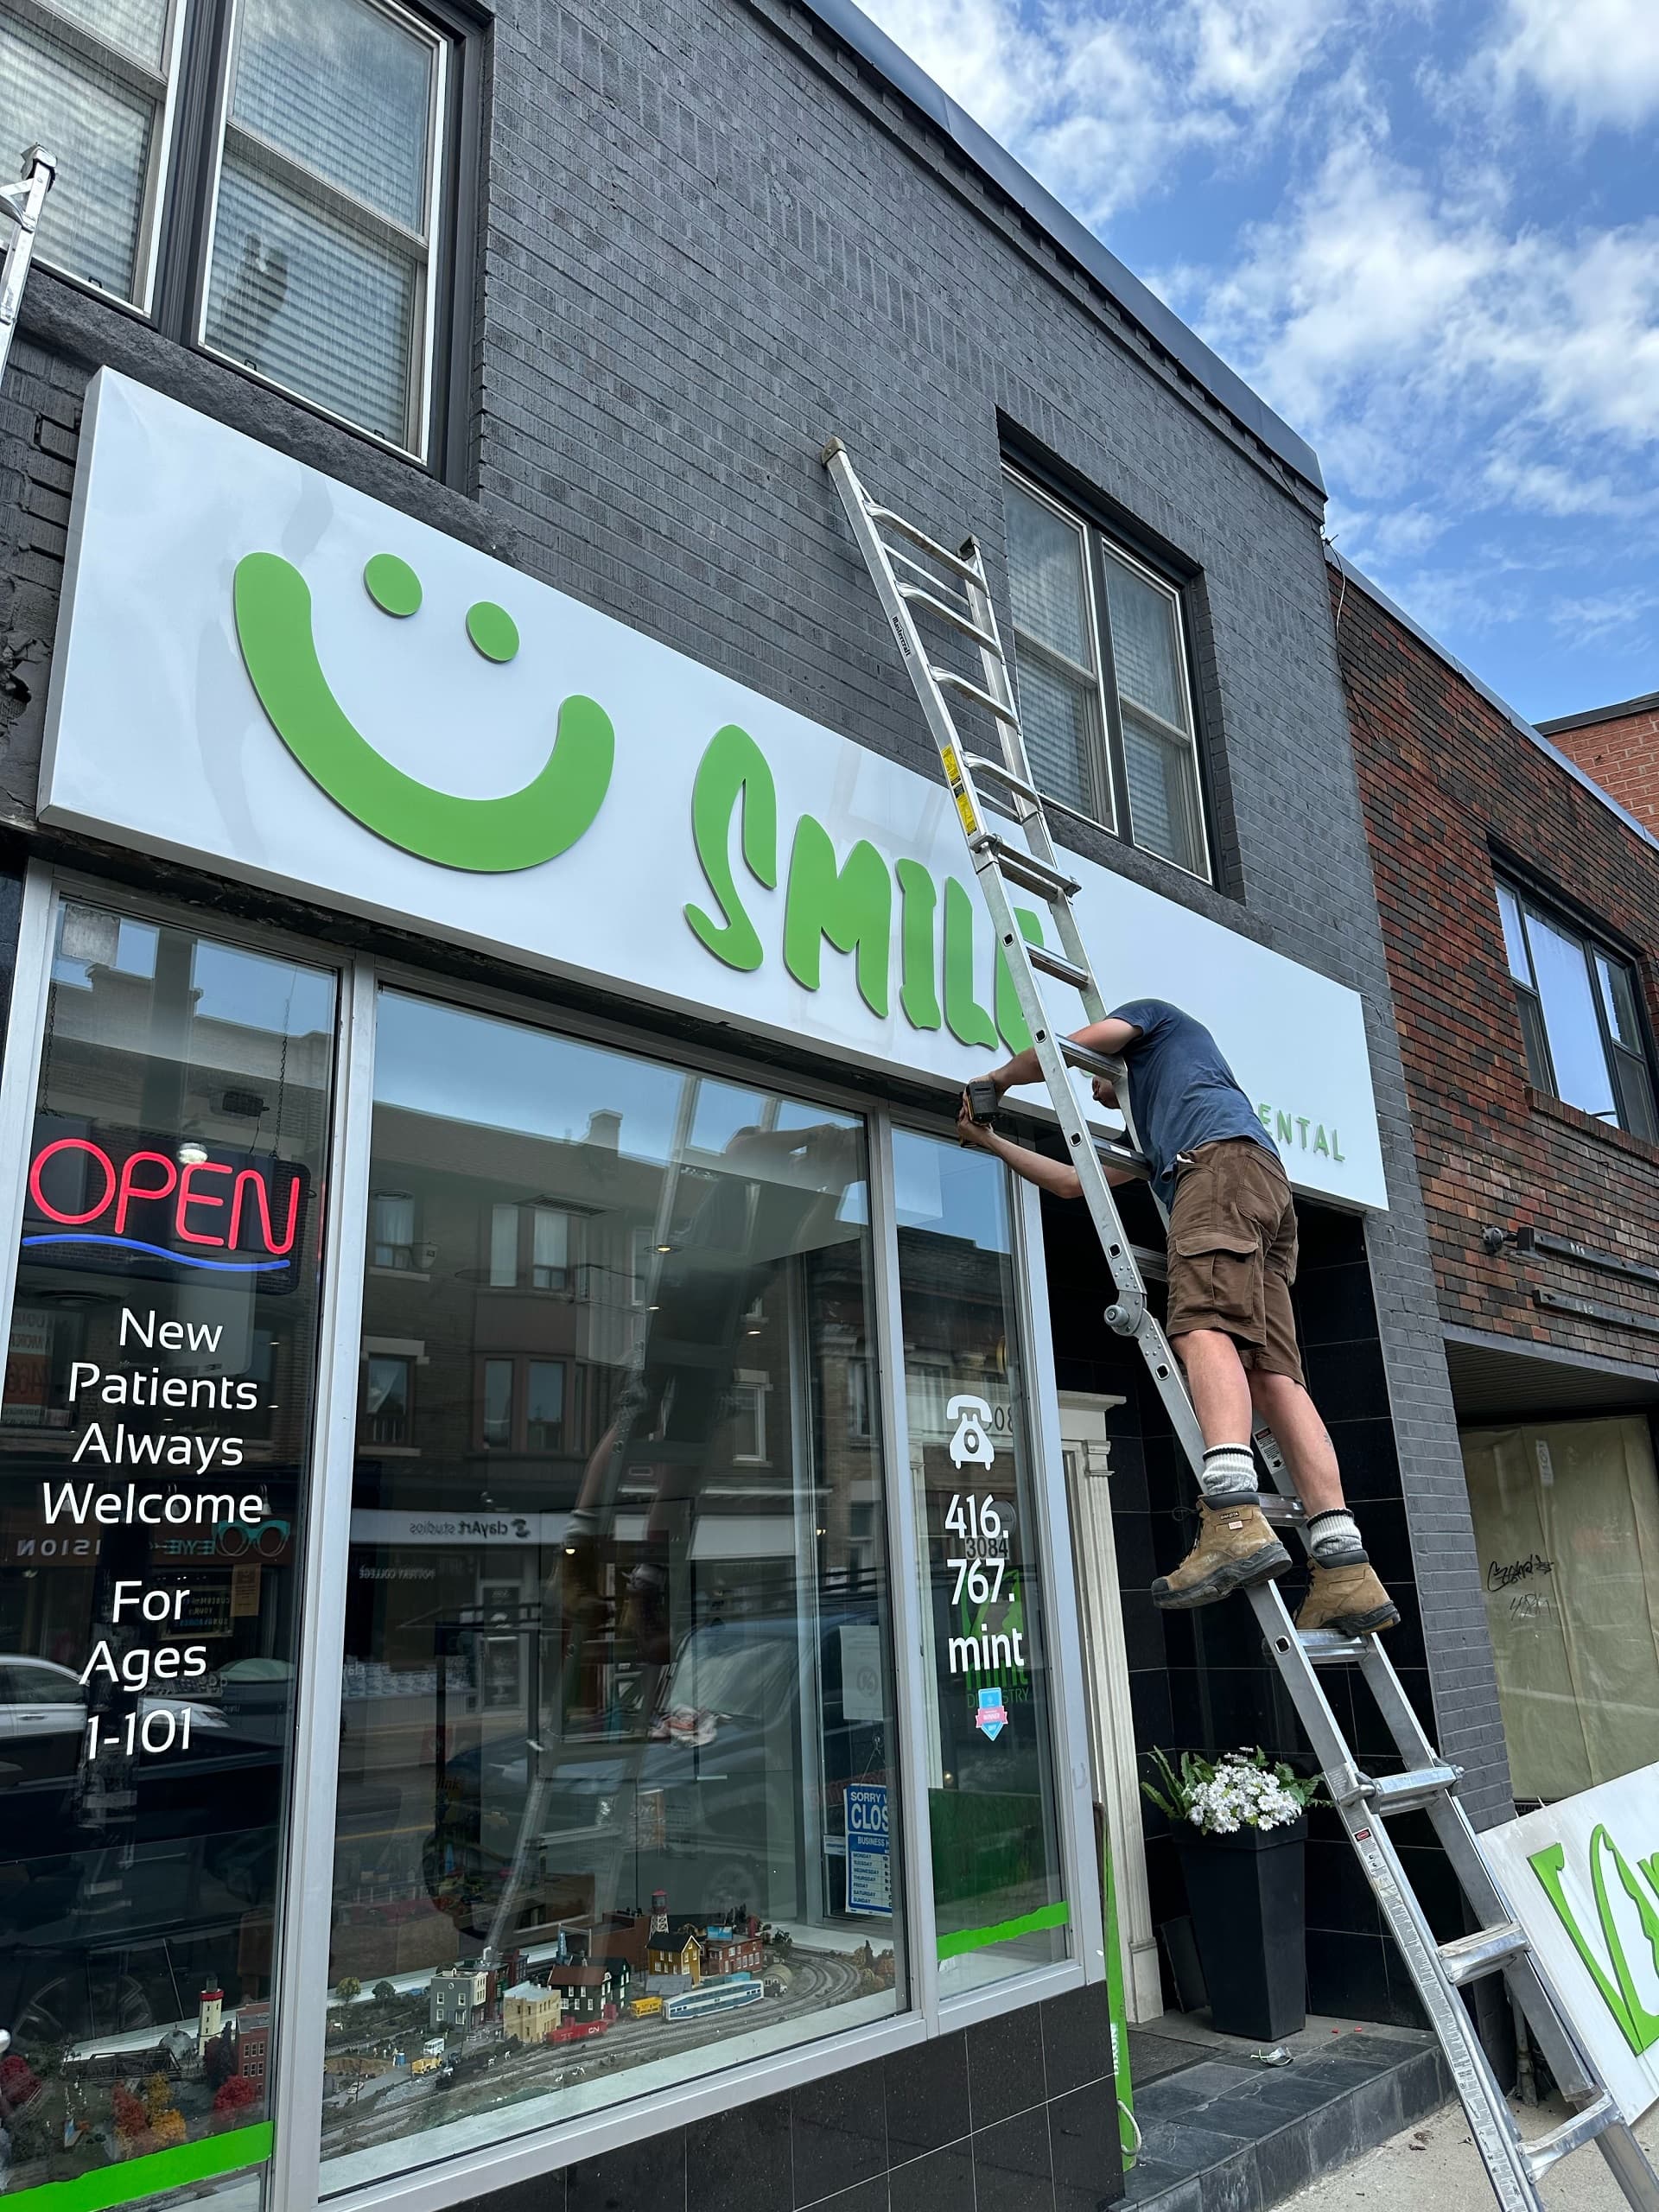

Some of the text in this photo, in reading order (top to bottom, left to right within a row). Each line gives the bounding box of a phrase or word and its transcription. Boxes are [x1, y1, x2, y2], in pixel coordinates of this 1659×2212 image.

[893, 616, 912, 658] Mastercraft
[1258, 1103, 1345, 1162] ENTAL
[29, 1138, 301, 1255] OPEN
[119, 1307, 224, 1353] New
[68, 1362, 257, 1410] Patients
[72, 1422, 244, 1475] Always
[43, 1482, 263, 1524] Welcome
[944, 1494, 1009, 1539] 416.
[965, 1537, 1008, 1559] 3084
[112, 1580, 191, 1624] For
[946, 1558, 1015, 1605] 767.
[79, 1640, 207, 1692] Ages
[948, 1623, 1025, 1674] mint
[967, 1687, 1029, 1708] DSTRY
[87, 1707, 192, 1760] 1-101
[850, 1791, 881, 1803] SORRY
[851, 1802, 889, 1832] CLOS
[857, 1836, 886, 1847] BUSINESS
[588, 2025, 600, 2034] CN
